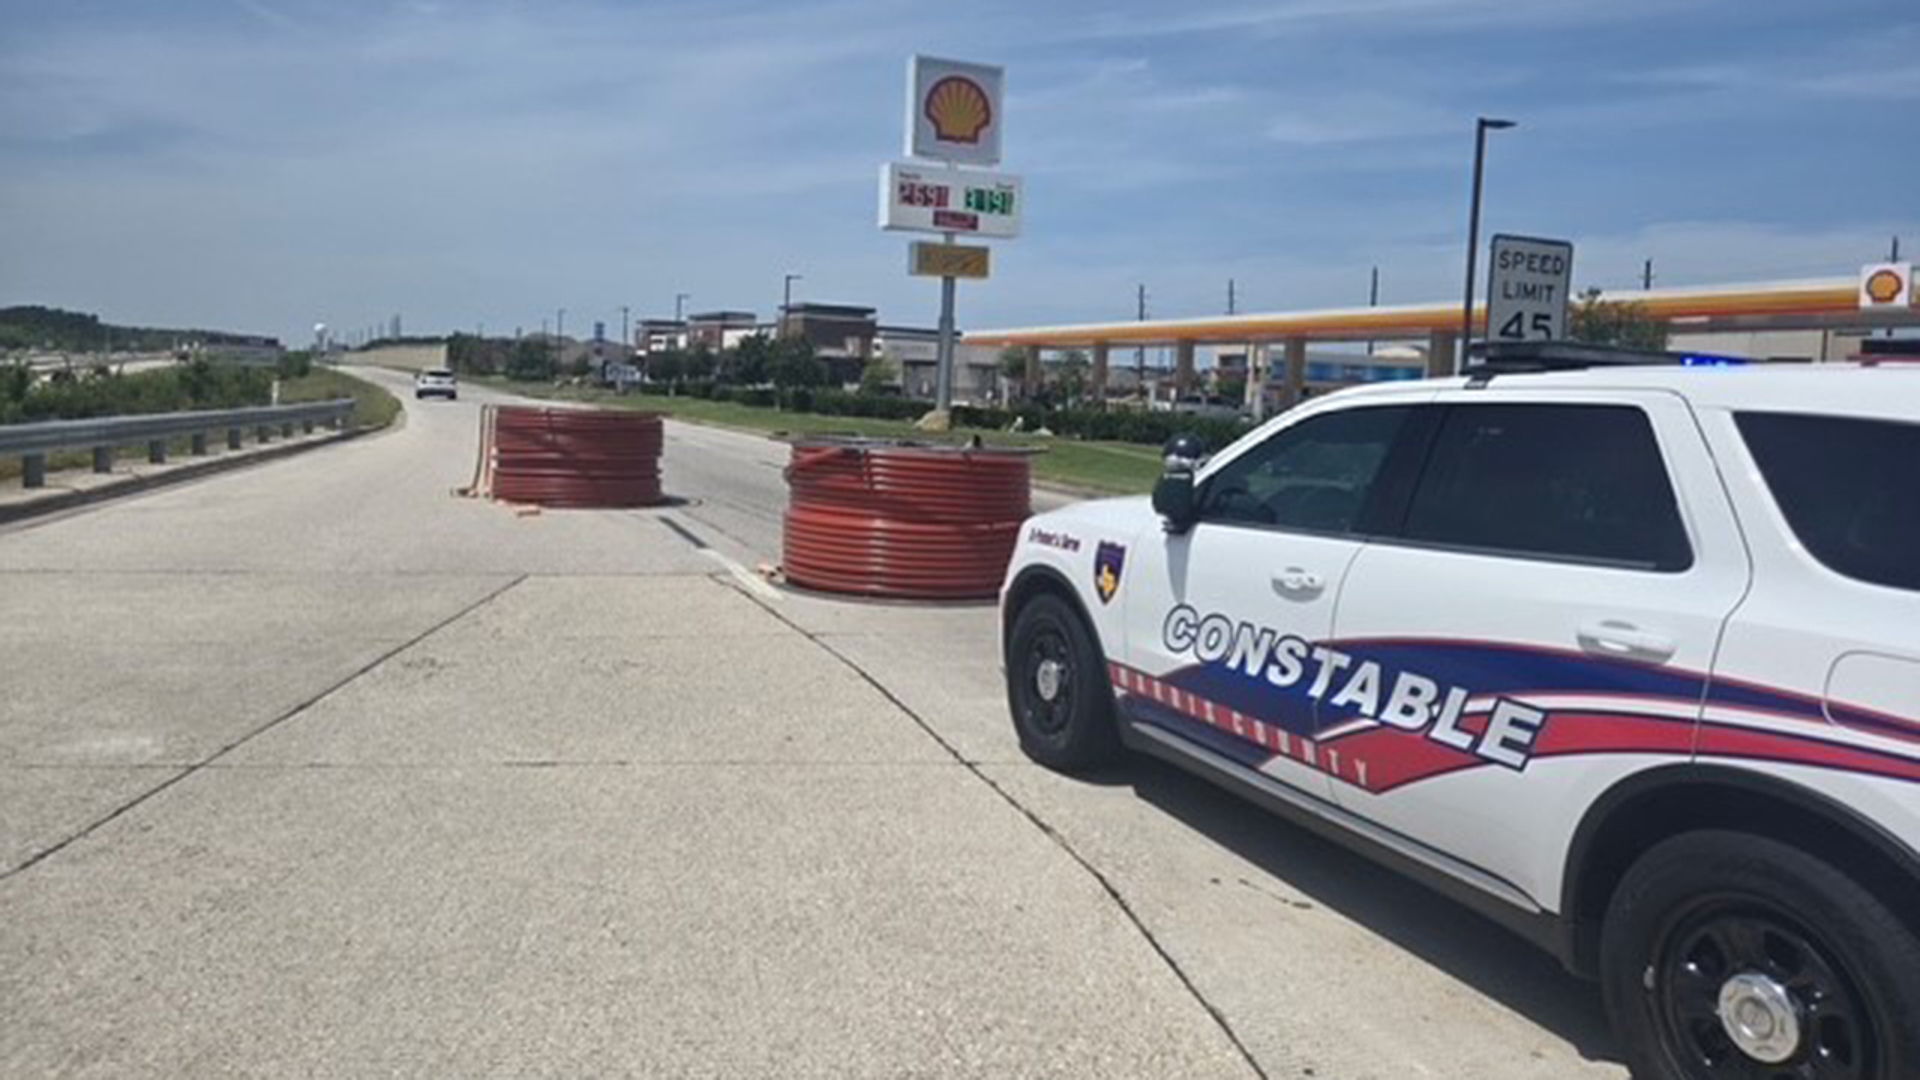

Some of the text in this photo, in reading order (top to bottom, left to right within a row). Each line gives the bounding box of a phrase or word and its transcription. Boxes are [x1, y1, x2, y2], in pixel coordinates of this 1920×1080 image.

[1499, 249, 1564, 275] SPEED
[1502, 281, 1554, 302] LIMIT
[1500, 311, 1552, 339] 45
[1164, 604, 1546, 772] CONSTABLE
